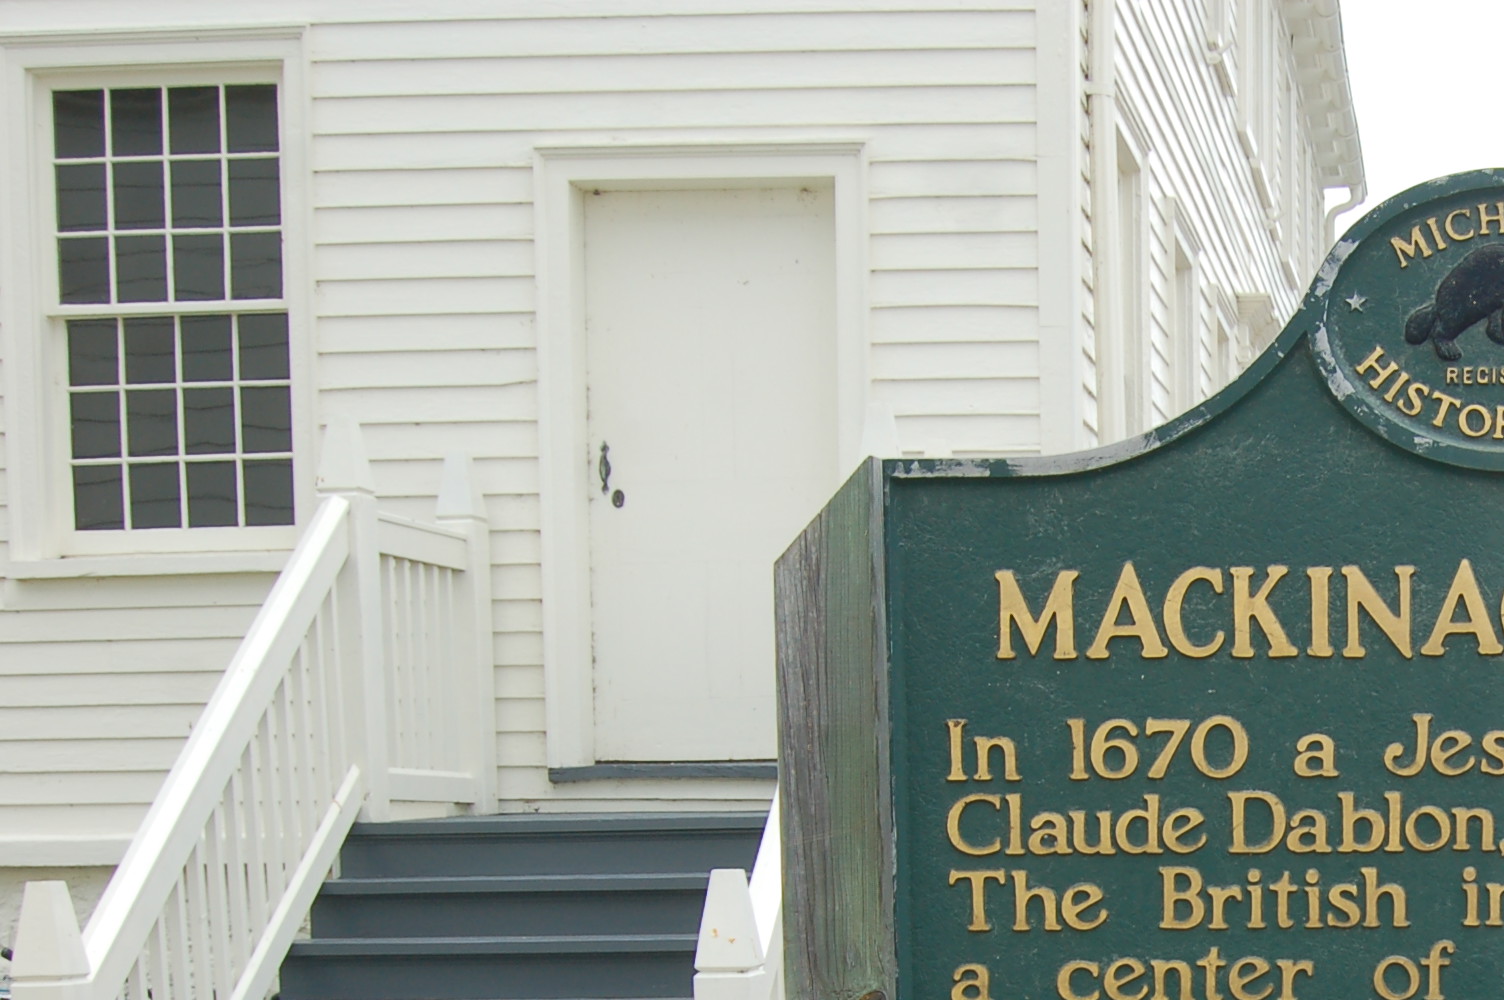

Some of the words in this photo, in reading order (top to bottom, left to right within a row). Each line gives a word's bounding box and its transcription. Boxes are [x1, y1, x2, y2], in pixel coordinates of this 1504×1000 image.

[946, 719, 1022, 781] In
[1066, 715, 1250, 780] 1670
[1293, 733, 1340, 778] a
[946, 792, 1208, 856] Claude
[948, 868, 1109, 932] The
[1159, 866, 1409, 930] British
